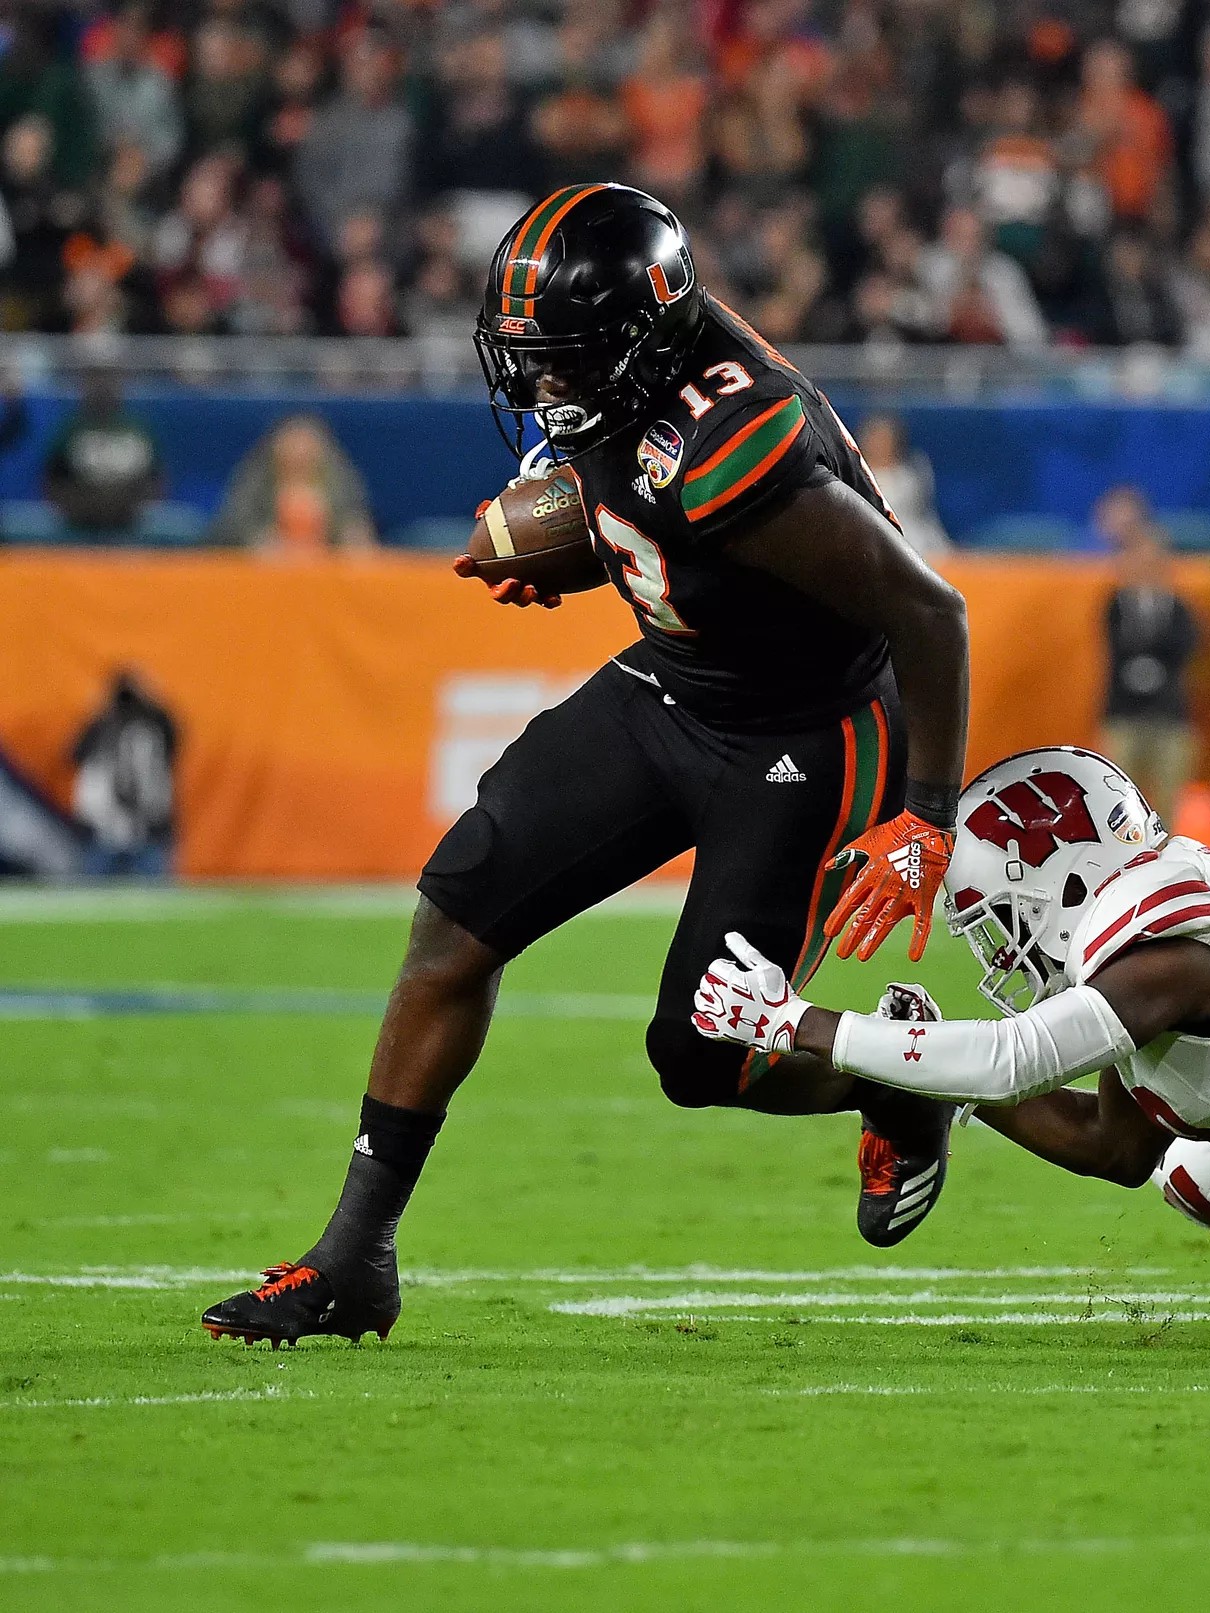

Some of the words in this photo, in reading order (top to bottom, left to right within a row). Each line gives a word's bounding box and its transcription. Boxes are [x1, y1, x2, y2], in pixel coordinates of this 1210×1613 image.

[500, 319, 526, 331] ACC
[678, 360, 756, 421] 13
[532, 494, 581, 518] adida
[765, 771, 808, 784] adidas
[963, 770, 1103, 869] W
[907, 842, 922, 889] adidas
